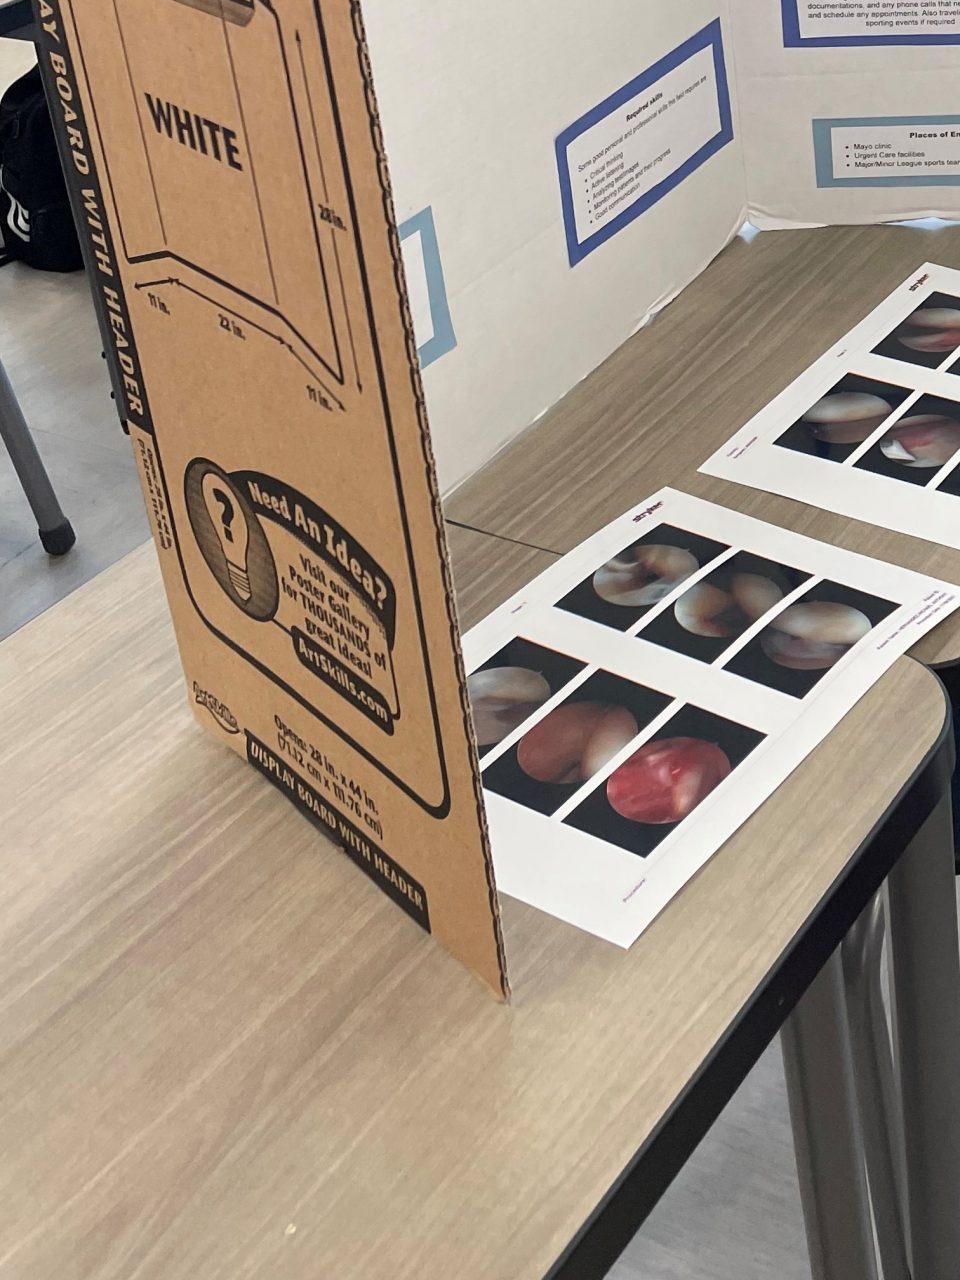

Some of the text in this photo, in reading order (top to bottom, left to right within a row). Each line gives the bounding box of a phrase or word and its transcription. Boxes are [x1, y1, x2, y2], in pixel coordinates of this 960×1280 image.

[144, 92, 243, 171] WHITE
[855, 160, 895, 168] Major/Minor
[50, 51, 90, 176] BOARD
[81, 188, 114, 277] WITH
[103, 284, 144, 417] HEADER
[248, 480, 388, 610] Need An Idea?
[299, 553, 350, 602] Visit our
[281, 576, 387, 671] for THOUSANDS of
[289, 564, 370, 639] Poster Gallery
[299, 637, 388, 723] ArtSkills.com
[305, 617, 372, 679] great ideas!
[274, 714, 379, 816] Opens: 28 in. x 44 in.
[277, 732, 383, 840] (71.12 cm x 111.76 cm)
[251, 742, 424, 911] DISPLAY BOARD WITH HEADER
